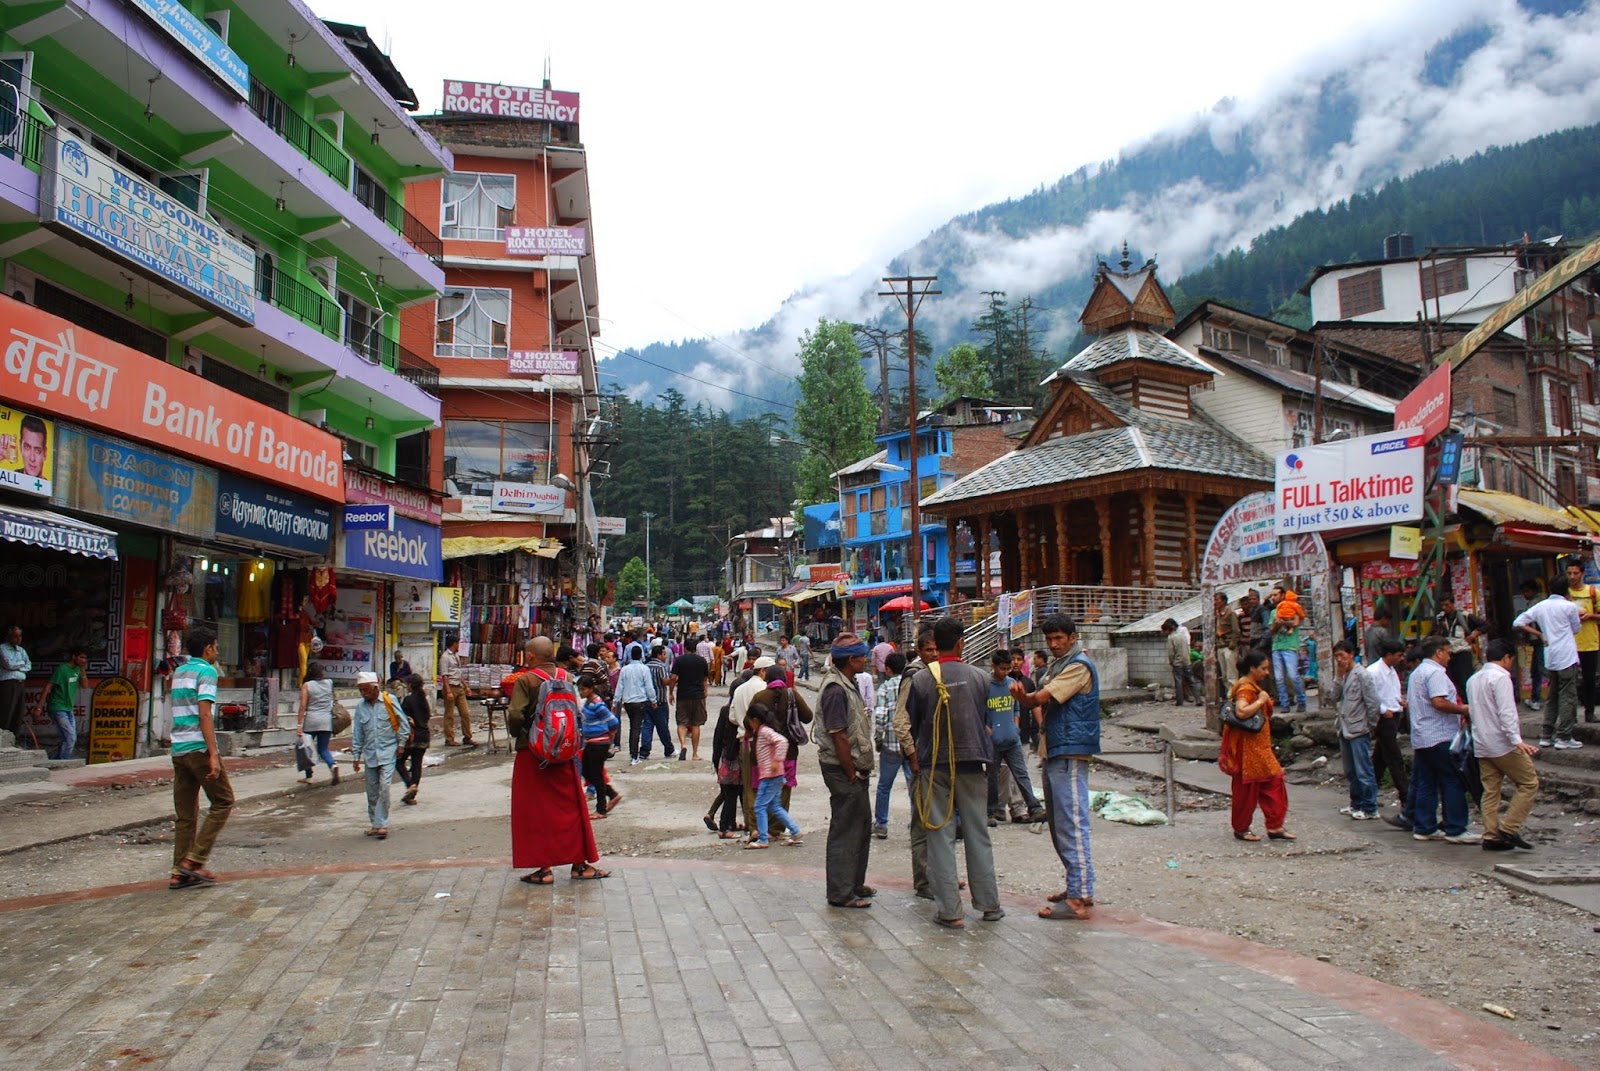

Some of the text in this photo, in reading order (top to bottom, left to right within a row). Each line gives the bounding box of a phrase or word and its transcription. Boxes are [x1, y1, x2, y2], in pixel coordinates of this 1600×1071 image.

[155, 0, 212, 51] ghway
[216, 48, 248, 81] Inn
[445, 95, 578, 122] ROCK REGENCY
[475, 84, 560, 105] HOTEL
[112, 168, 220, 246] WELCOME
[98, 177, 230, 271] HOTEL
[525, 228, 572, 238] HOTEL
[62, 178, 254, 313] HIGHWAY INN
[508, 237, 585, 249] ROCK REGENCY
[64, 213, 254, 320] THE MALL MANALI 175131 DISTT. KULLU H.P.
[4, 328, 118, 412] बड़ौदा
[510, 359, 577, 370] ROCK REGENCY
[525, 352, 567, 361] HOTEL
[1407, 392, 1445, 428] vodafone
[142, 382, 339, 488] Bank of Baroda
[1373, 440, 1406, 453] AIRCEL
[92, 443, 190, 488] DRAGON
[103, 471, 180, 504] SHOPPING
[348, 471, 382, 497] HOTEL
[385, 485, 430, 511] HIGHWAY
[499, 488, 560, 501] Delhi Mughlai
[1282, 474, 1414, 510] FULL Talktime
[267, 508, 293, 535] CRAFT
[292, 515, 329, 541] EMPORIUM
[345, 511, 386, 523] Reebok
[1283, 502, 1410, 530] at just ₹50 & above
[3, 520, 100, 554] MEDICAL HALL
[364, 530, 429, 567] Reebok
[449, 589, 460, 620] Nikon
[320, 664, 364, 675] OLPIX
[94, 707, 135, 718] DRAGON
[95, 720, 132, 729] MARKET
